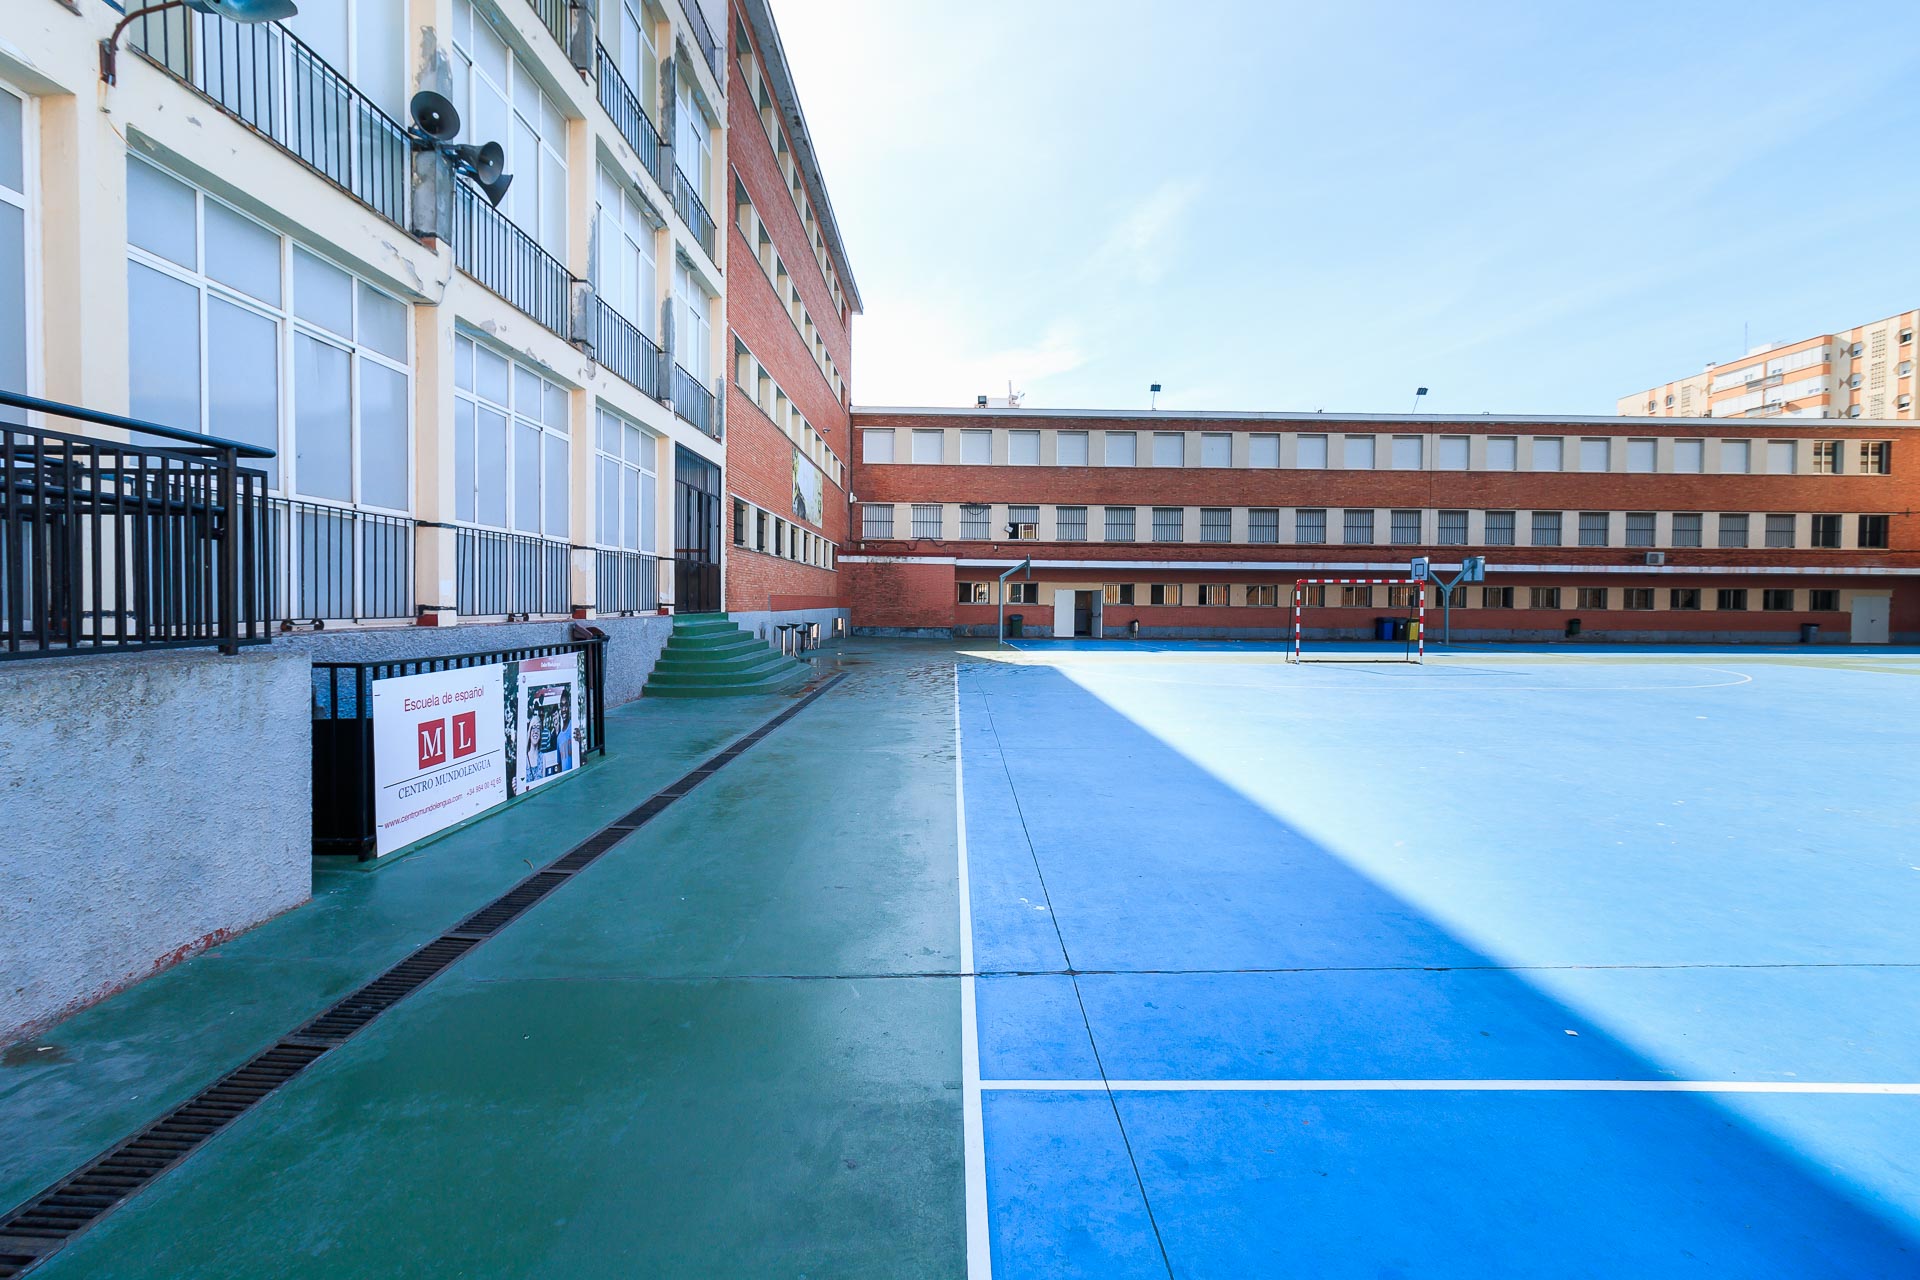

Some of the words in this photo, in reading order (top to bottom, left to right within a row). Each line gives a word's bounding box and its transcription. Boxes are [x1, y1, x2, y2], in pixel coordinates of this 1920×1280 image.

[404, 694, 440, 712] Escuela
[442, 692, 453, 704] de
[455, 685, 484, 702] español
[398, 778, 434, 800] CENTRO
[435, 759, 491, 787] MUNDOLENGUA
[384, 793, 463, 829] www.centromundolengua.com
